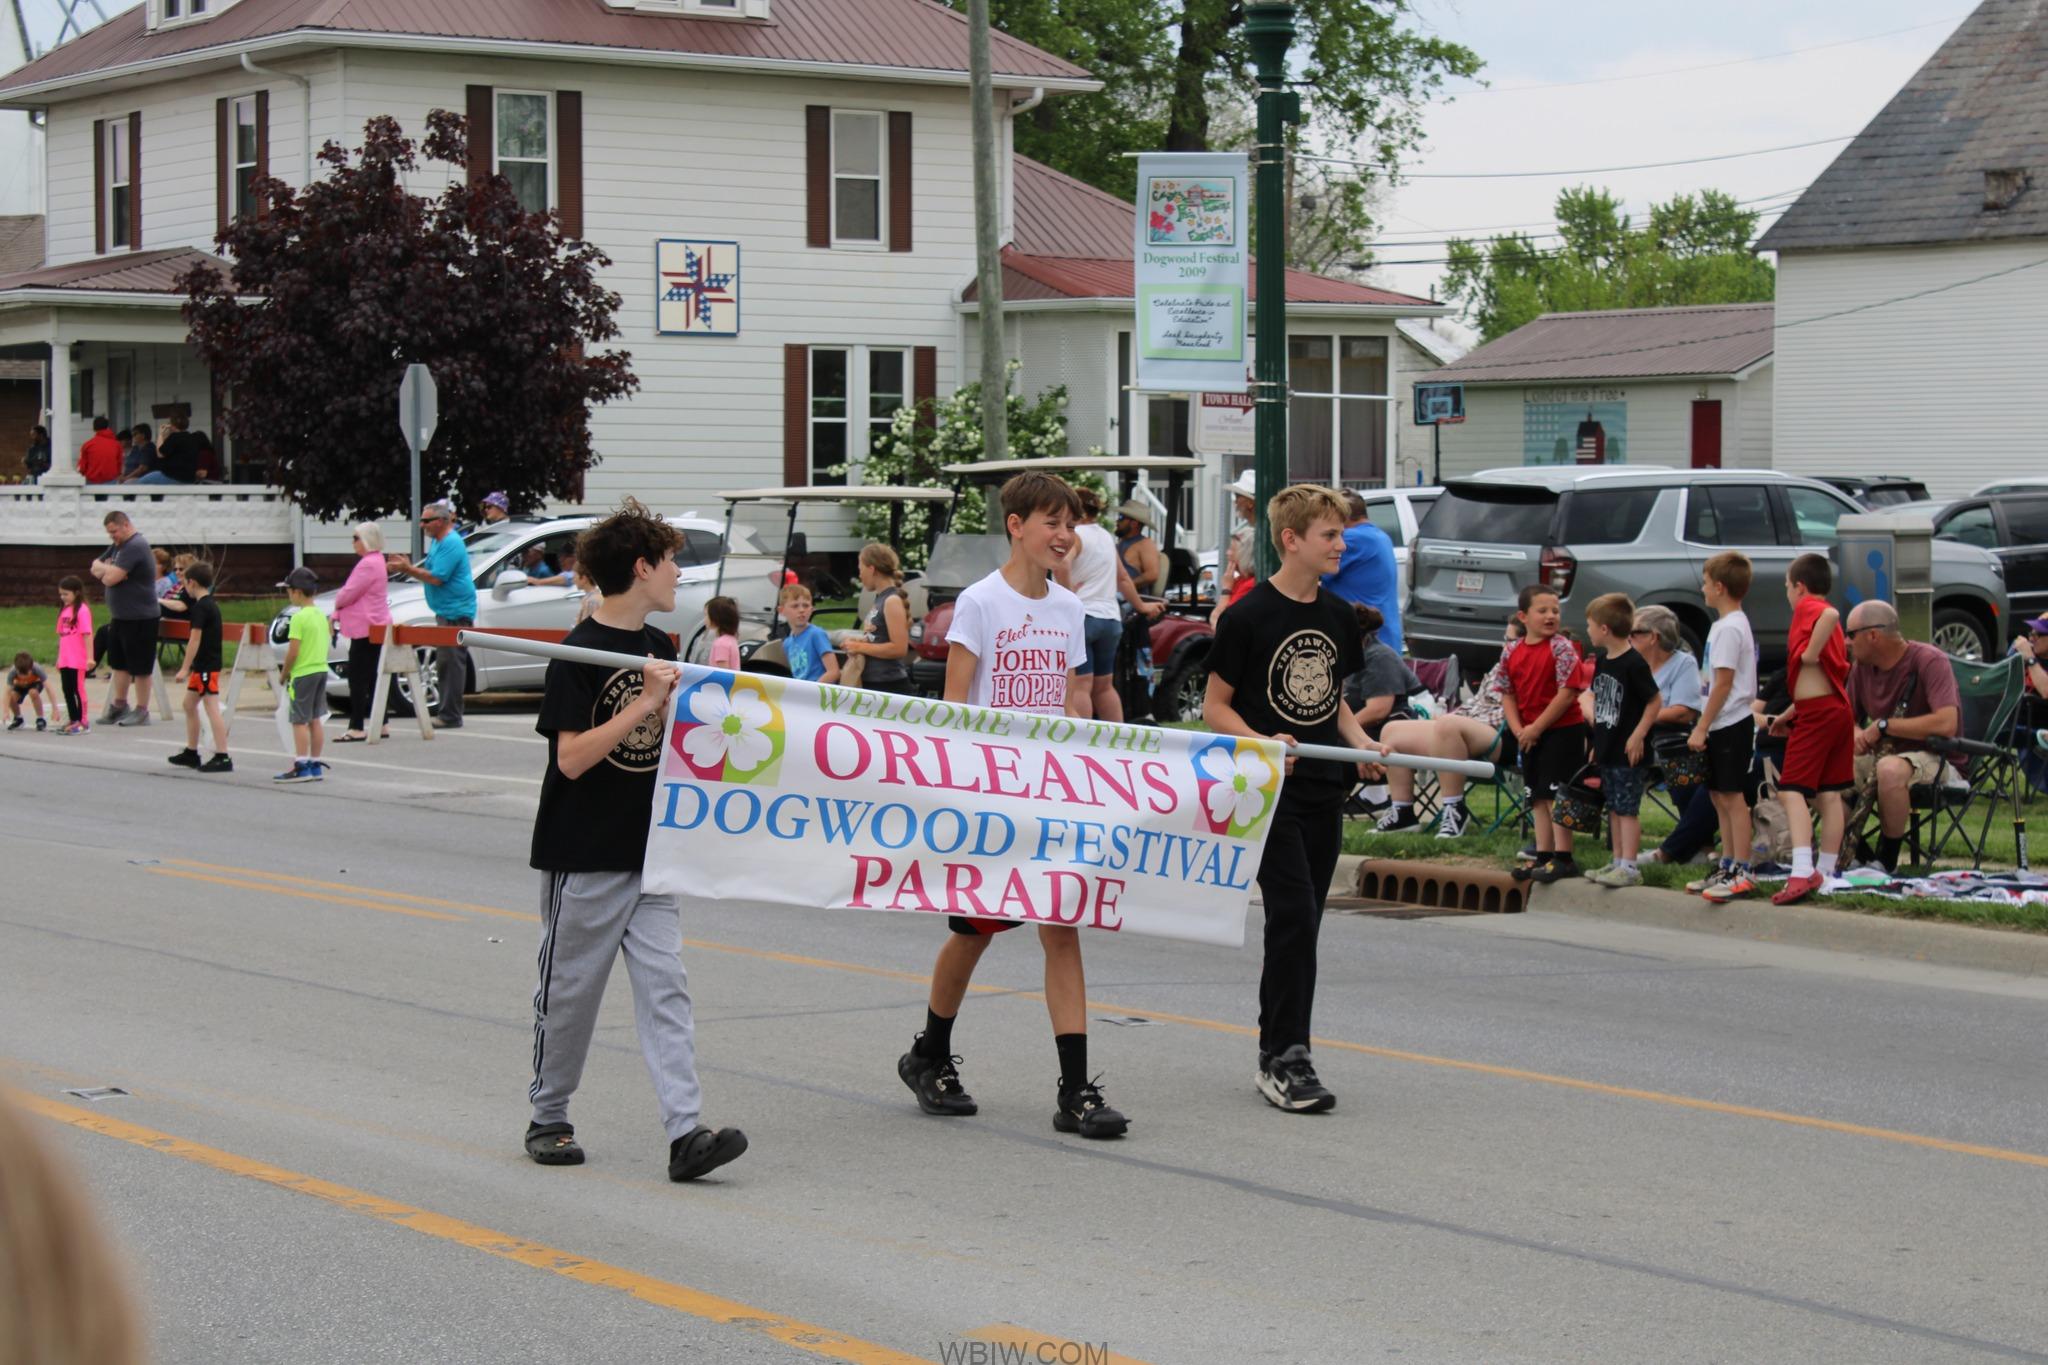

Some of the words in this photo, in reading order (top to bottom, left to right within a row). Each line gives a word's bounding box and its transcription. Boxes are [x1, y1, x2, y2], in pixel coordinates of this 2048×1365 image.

[1143, 252, 1197, 268] Dogwood
[1199, 251, 1240, 264] Festival
[1178, 267, 1207, 278] 2009
[1205, 393, 1231, 406] TOWN
[1231, 394, 1254, 406] HALL
[995, 623, 1031, 649] Elect
[992, 649, 1051, 672] JOHN
[1277, 644, 1296, 671] THE
[1297, 637, 1337, 667] PAWLOR
[603, 680, 627, 706] THE
[991, 673, 1067, 708] HOPPE
[817, 684, 1016, 737] WELCOME
[1025, 715, 1077, 744] TO
[1086, 722, 1164, 755] THE
[623, 749, 661, 761] GROOM
[813, 721, 1179, 815] ORLEANS
[657, 782, 1017, 857] DOGWOOD
[1029, 816, 1251, 891] FESTIVAL
[846, 854, 1127, 932] PARADE
